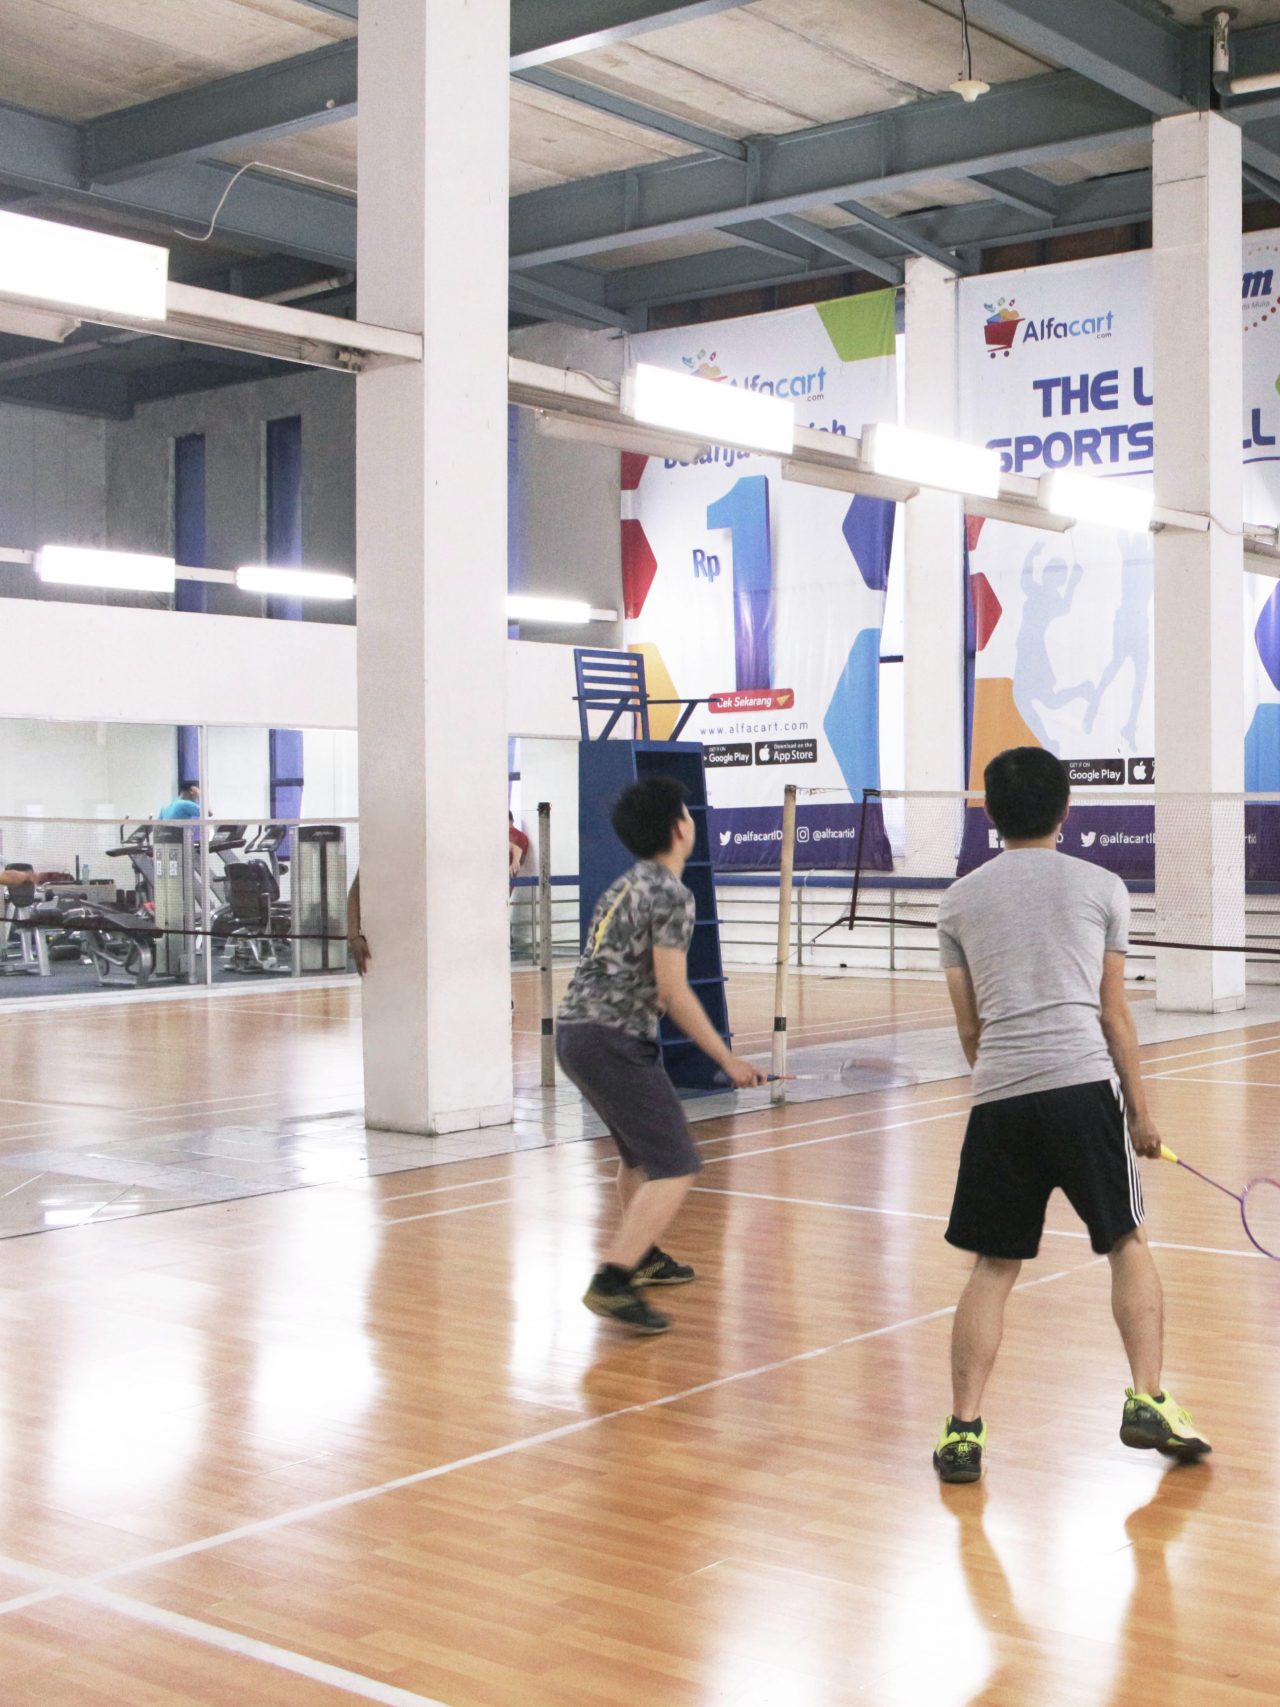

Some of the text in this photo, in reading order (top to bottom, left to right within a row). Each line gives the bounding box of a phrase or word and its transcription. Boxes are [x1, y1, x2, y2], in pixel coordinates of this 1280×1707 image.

[1022, 310, 1114, 343] Alfacart
[1033, 369, 1118, 417] THE
[985, 421, 1153, 473] SPORTS
[692, 475, 774, 691] Rp 1
[733, 695, 772, 708] Sekarang
[699, 721, 809, 736] www.alfacart.com
[708, 752, 750, 764] Google Play
[773, 750, 813, 763] App Store
[1069, 768, 1121, 782] Google Play
